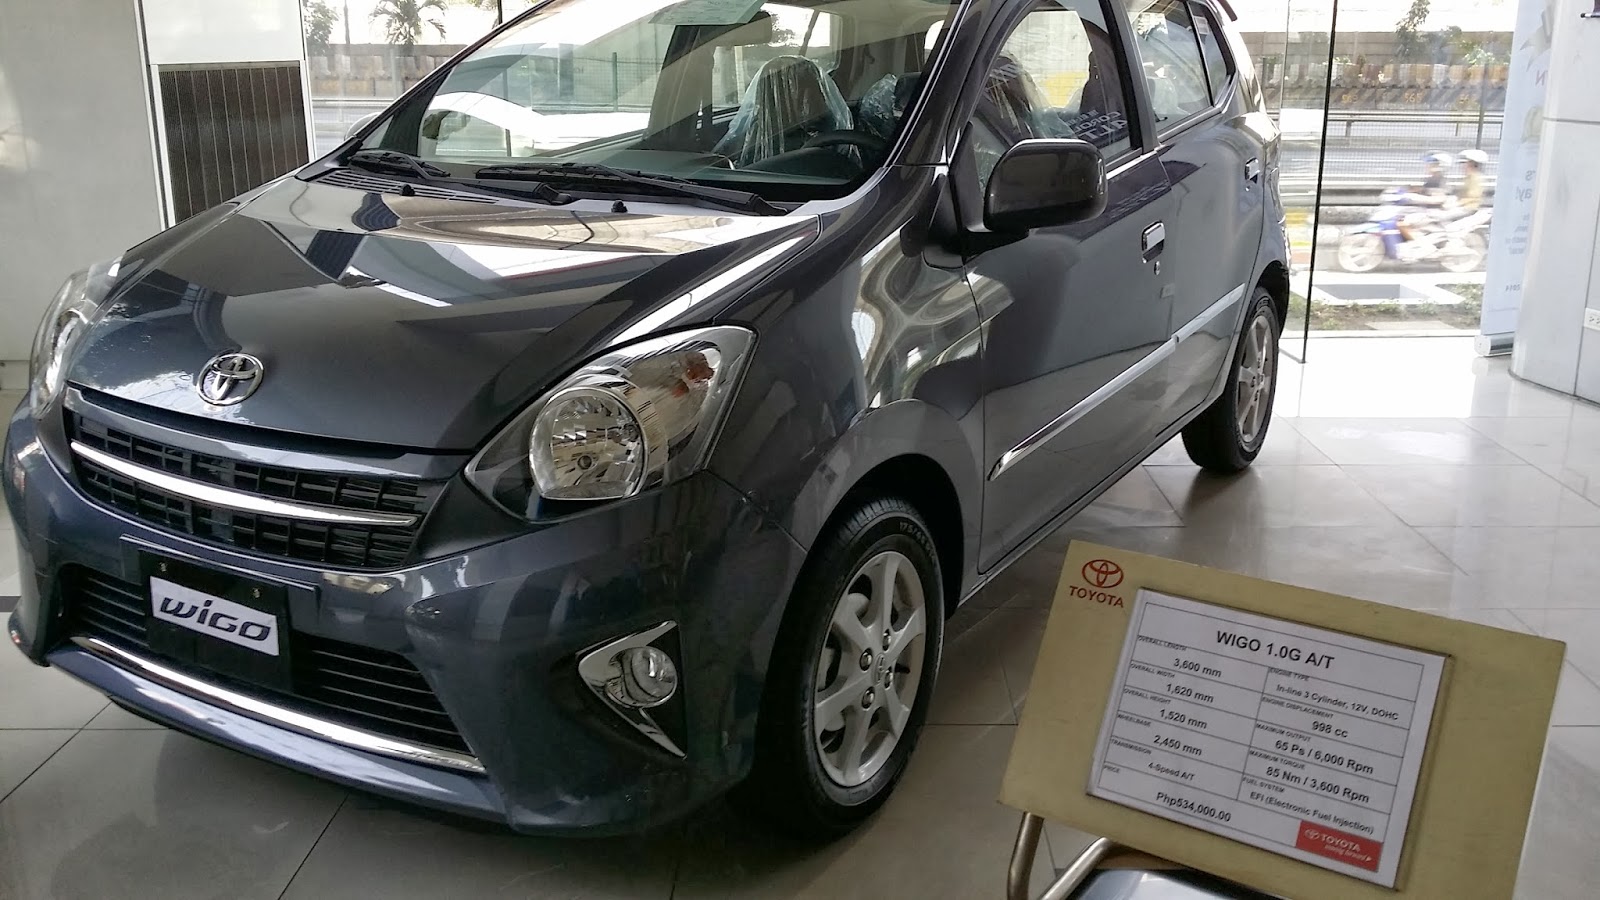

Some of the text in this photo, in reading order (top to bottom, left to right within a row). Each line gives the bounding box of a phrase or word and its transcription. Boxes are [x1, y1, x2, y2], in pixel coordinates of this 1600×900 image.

[1069, 585, 1124, 608] TOYOTA
[1138, 635, 1187, 652] OVERALL LENGTH
[1216, 630, 1335, 669] WIGO 1.0G A/T
[1131, 663, 1176, 679] OVERALL WIDTH
[1173, 658, 1222, 678] 3,600 mm
[1269, 667, 1310, 682] ENGINE TYPE
[1124, 688, 1171, 705] OVERALL HEIGHT
[1166, 683, 1214, 703] 1,620 mm
[1276, 684, 1399, 721] In-line 3 Cylinder, 12V, DOHC
[1262, 696, 1334, 719] ENGINE DISPLACEMENT
[1117, 713, 1151, 727] WHEELBASE
[1160, 708, 1208, 729] 1,520 mm
[1256, 723, 1312, 742] MAXIMUM OUTPUT
[1312, 721, 1348, 738] 998 cc
[1111, 738, 1152, 755] TRANSMISSION
[1153, 734, 1203, 756] 2,450 mm
[1249, 750, 1306, 770] MAXIMUM TORQUE
[1275, 740, 1288, 751] 65
[1290, 744, 1305, 756] Ps
[1314, 750, 1344, 767] 6,000
[1346, 759, 1374, 775] Rpm
[1103, 764, 1120, 774] PRICE
[1148, 762, 1195, 782] 4-Speed A/T
[1242, 776, 1285, 793] FUEL SYSTEM
[1266, 766, 1280, 778] 85
[1281, 770, 1301, 784] Nm
[1309, 778, 1340, 795] 3,600
[1342, 788, 1370, 803] Rpm
[1156, 792, 1232, 823] Php534,000.00
[1250, 791, 1375, 835] EFI (Electronic Fuel Injection)
[1321, 833, 1361, 853] TOYOTA
